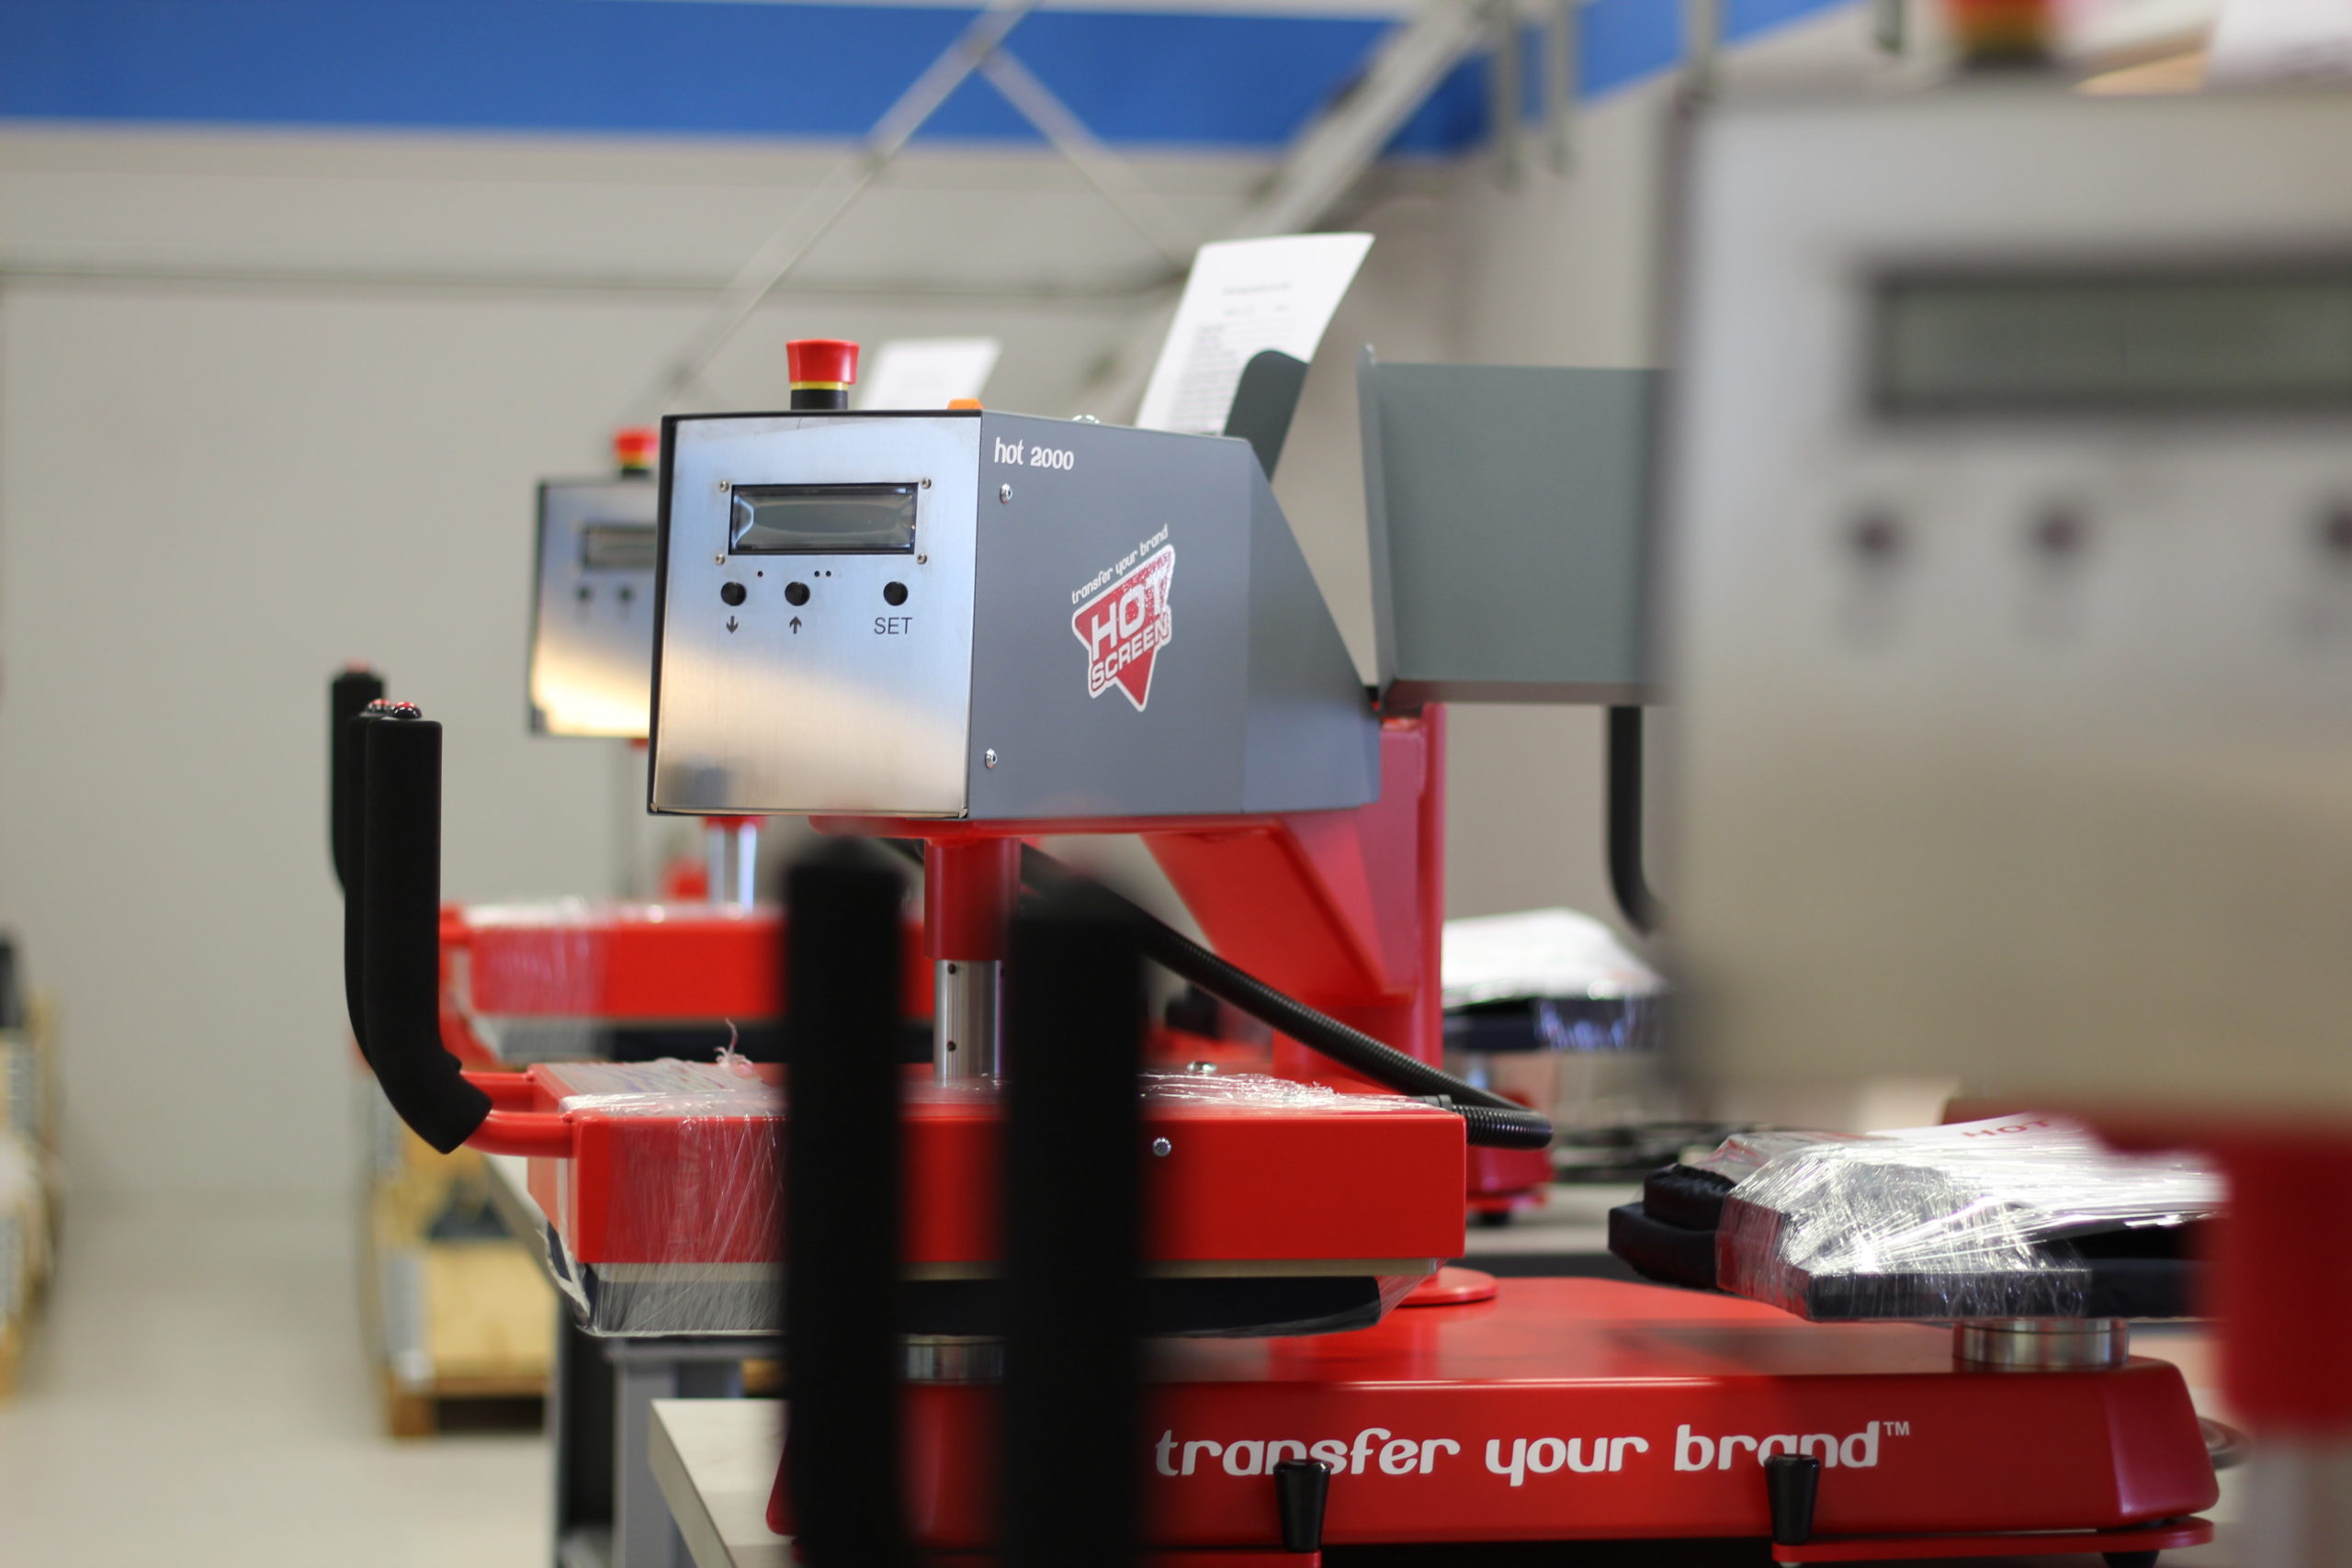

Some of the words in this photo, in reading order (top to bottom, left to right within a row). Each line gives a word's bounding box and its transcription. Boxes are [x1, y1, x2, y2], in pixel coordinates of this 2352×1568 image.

[994, 436, 1024, 466] hot
[1030, 446, 1074, 470] 2000
[1071, 570, 1114, 605] transfer
[1114, 549, 1138, 577] your
[1139, 524, 1169, 557] brand
[874, 616, 913, 635] SET
[1091, 564, 1170, 662] HOT
[1090, 608, 1170, 691] SCREEN
[1155, 1427, 1461, 1476] transfer
[1485, 1436, 1649, 1487] your
